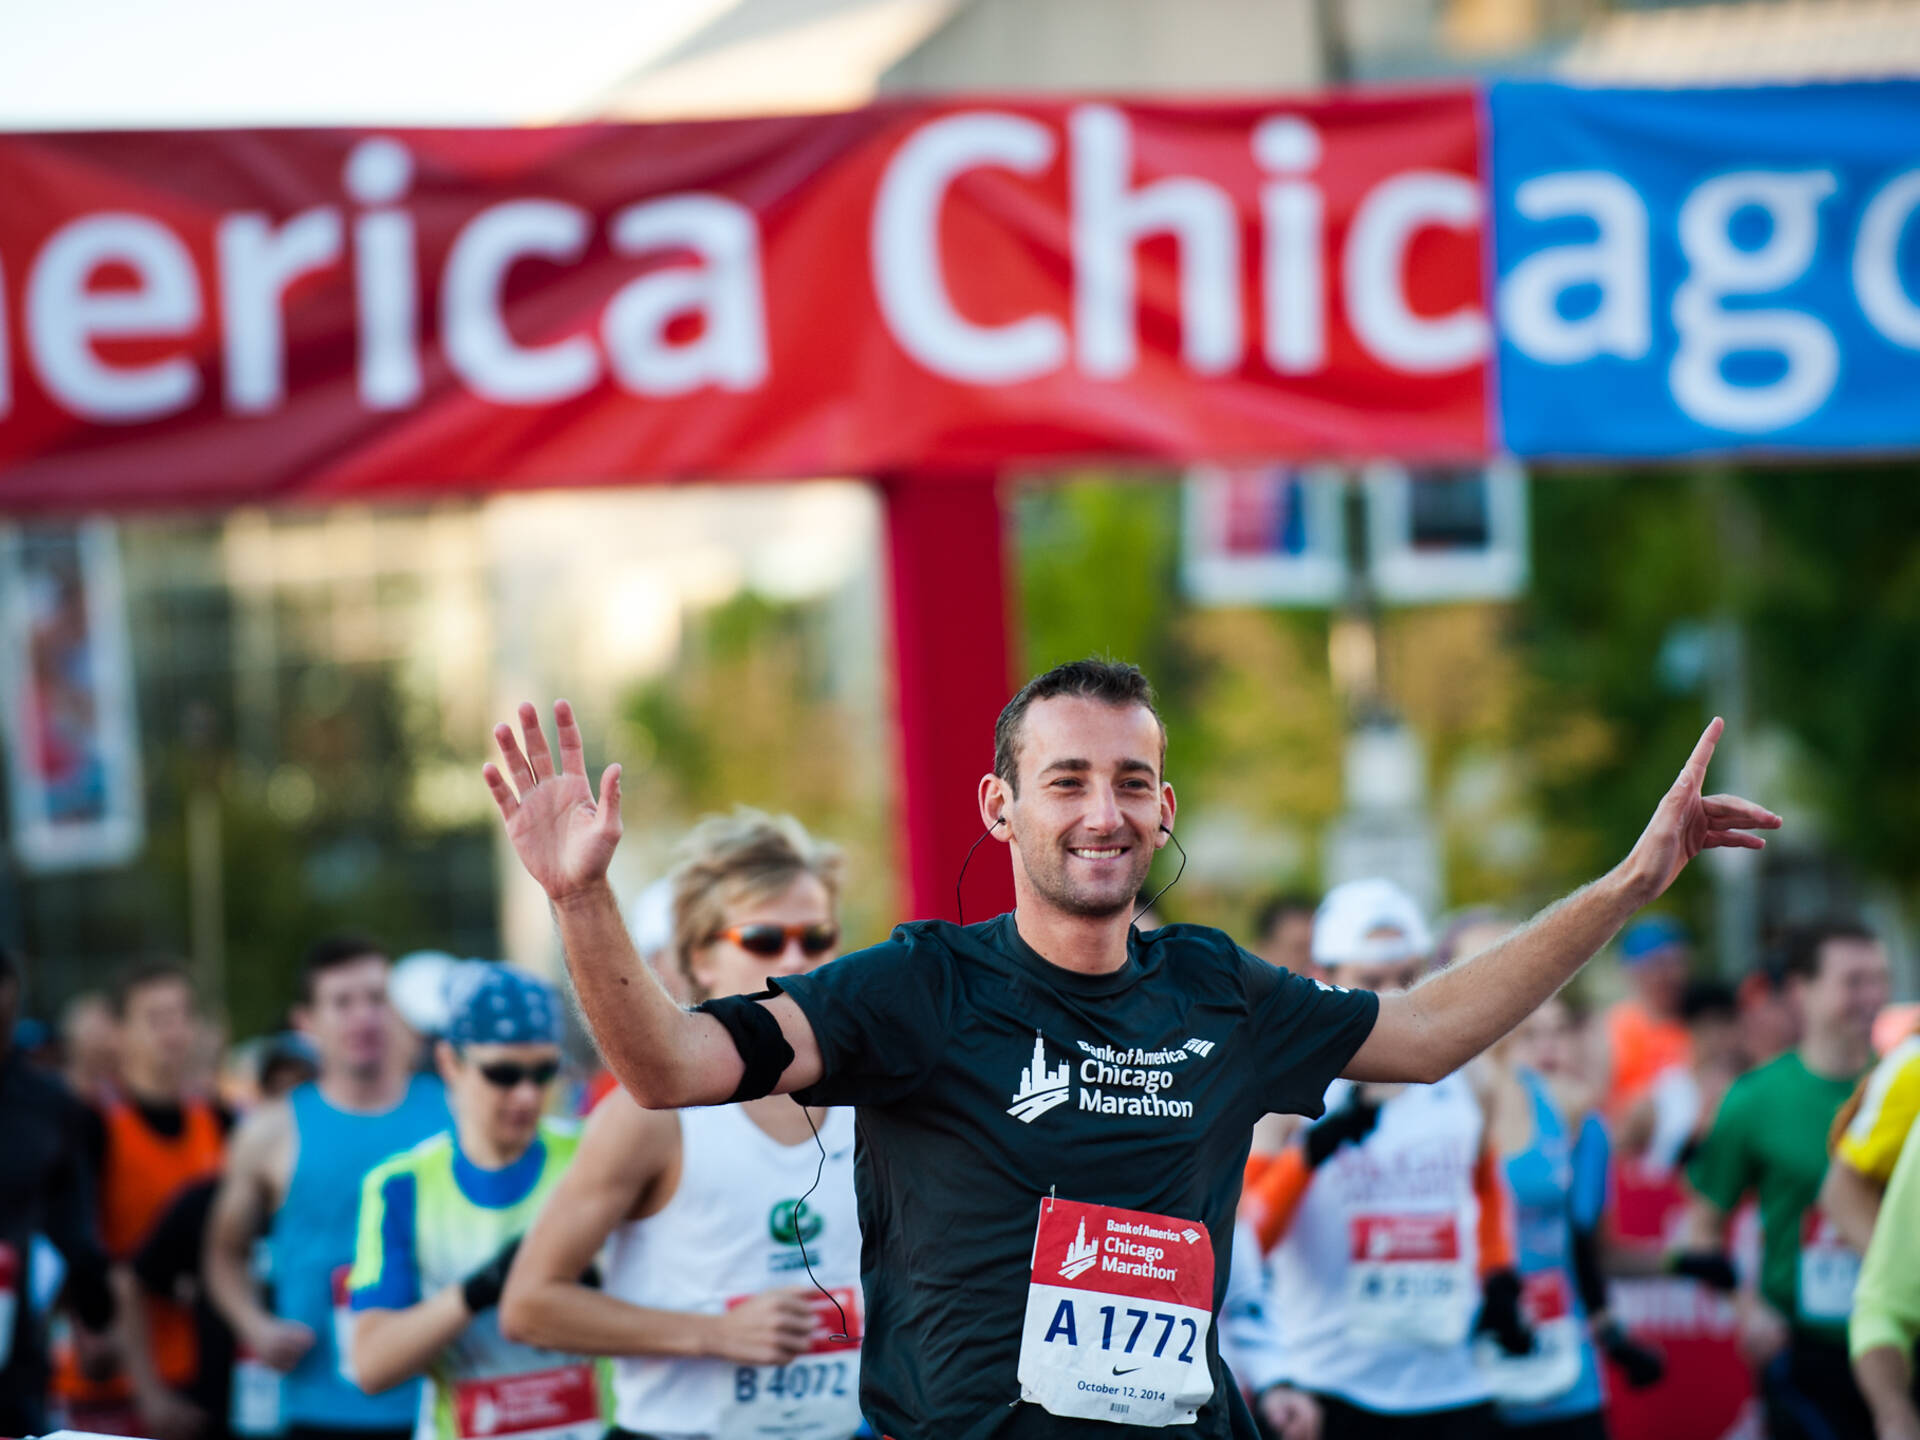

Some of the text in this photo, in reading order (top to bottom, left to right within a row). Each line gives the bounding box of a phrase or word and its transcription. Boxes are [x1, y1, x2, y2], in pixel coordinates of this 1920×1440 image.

[0, 134, 771, 424] erica
[1076, 1040, 1188, 1066] Bank of America
[1080, 1058, 1174, 1094] Chicago
[1078, 1086, 1194, 1118] Marathon
[1106, 1218, 1181, 1243] Bank of America
[1103, 1235, 1165, 1263] Chicago
[1101, 1254, 1177, 1282] Marathon
[1044, 1298, 1198, 1365] A 1772
[734, 1365, 758, 1403] B
[1077, 1380, 1166, 1402] October 12, 2014
